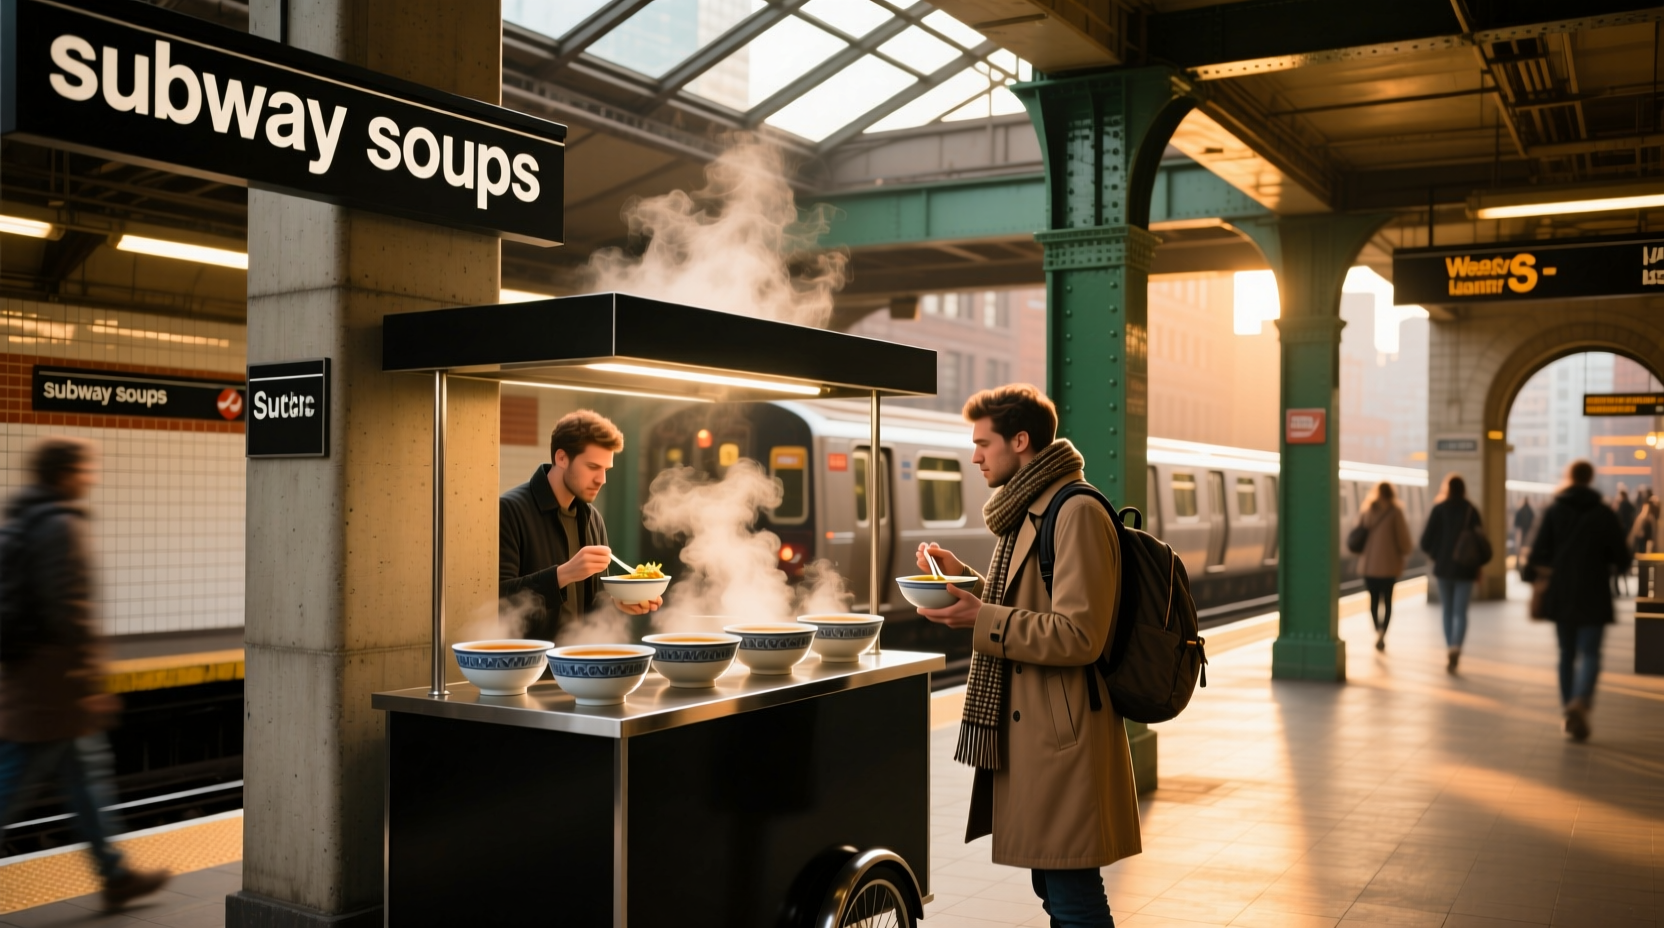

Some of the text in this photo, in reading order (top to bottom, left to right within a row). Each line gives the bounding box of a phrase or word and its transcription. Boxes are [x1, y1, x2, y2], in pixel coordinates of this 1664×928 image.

[49, 34, 541, 210] subway soups
[43, 379, 168, 408] subway soups
